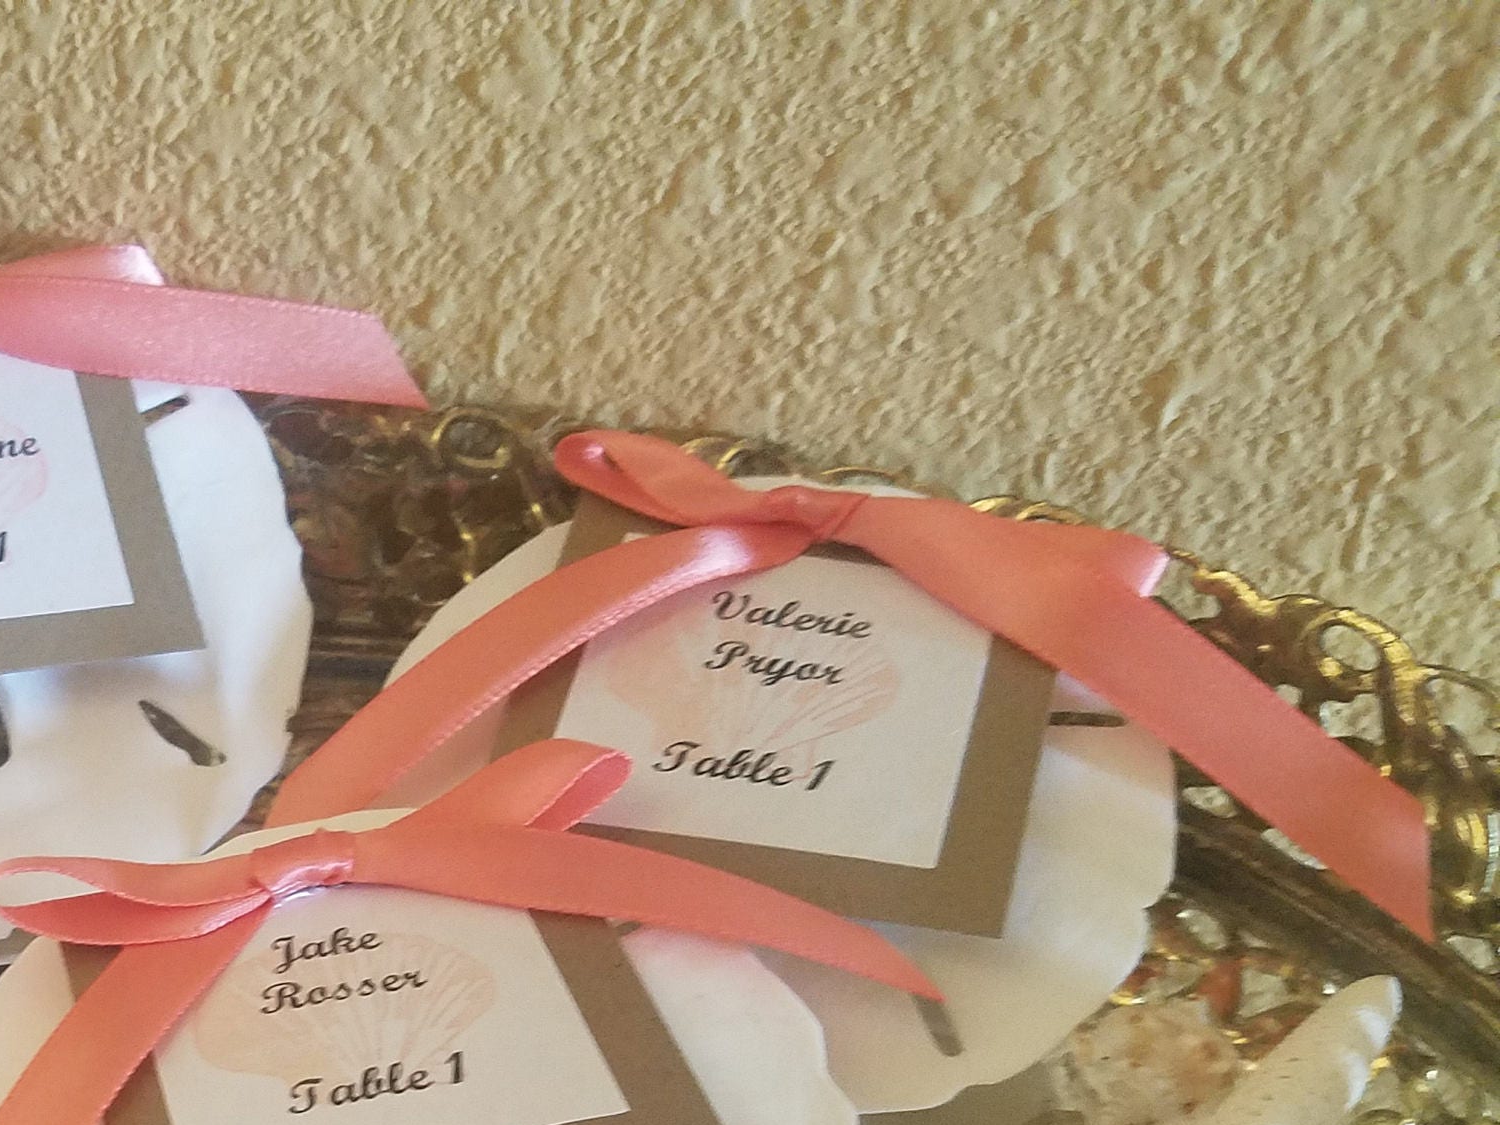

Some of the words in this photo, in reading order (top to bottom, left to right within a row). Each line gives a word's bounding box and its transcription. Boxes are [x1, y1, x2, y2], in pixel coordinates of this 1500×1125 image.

[712, 591, 871, 638] Valerie
[704, 641, 844, 686] Pryor
[652, 741, 792, 786] Table
[805, 761, 837, 790] 1
[271, 927, 383, 974] Jake
[260, 970, 428, 1014] Rosser
[288, 1062, 434, 1113] Table
[444, 1051, 464, 1083] 1
